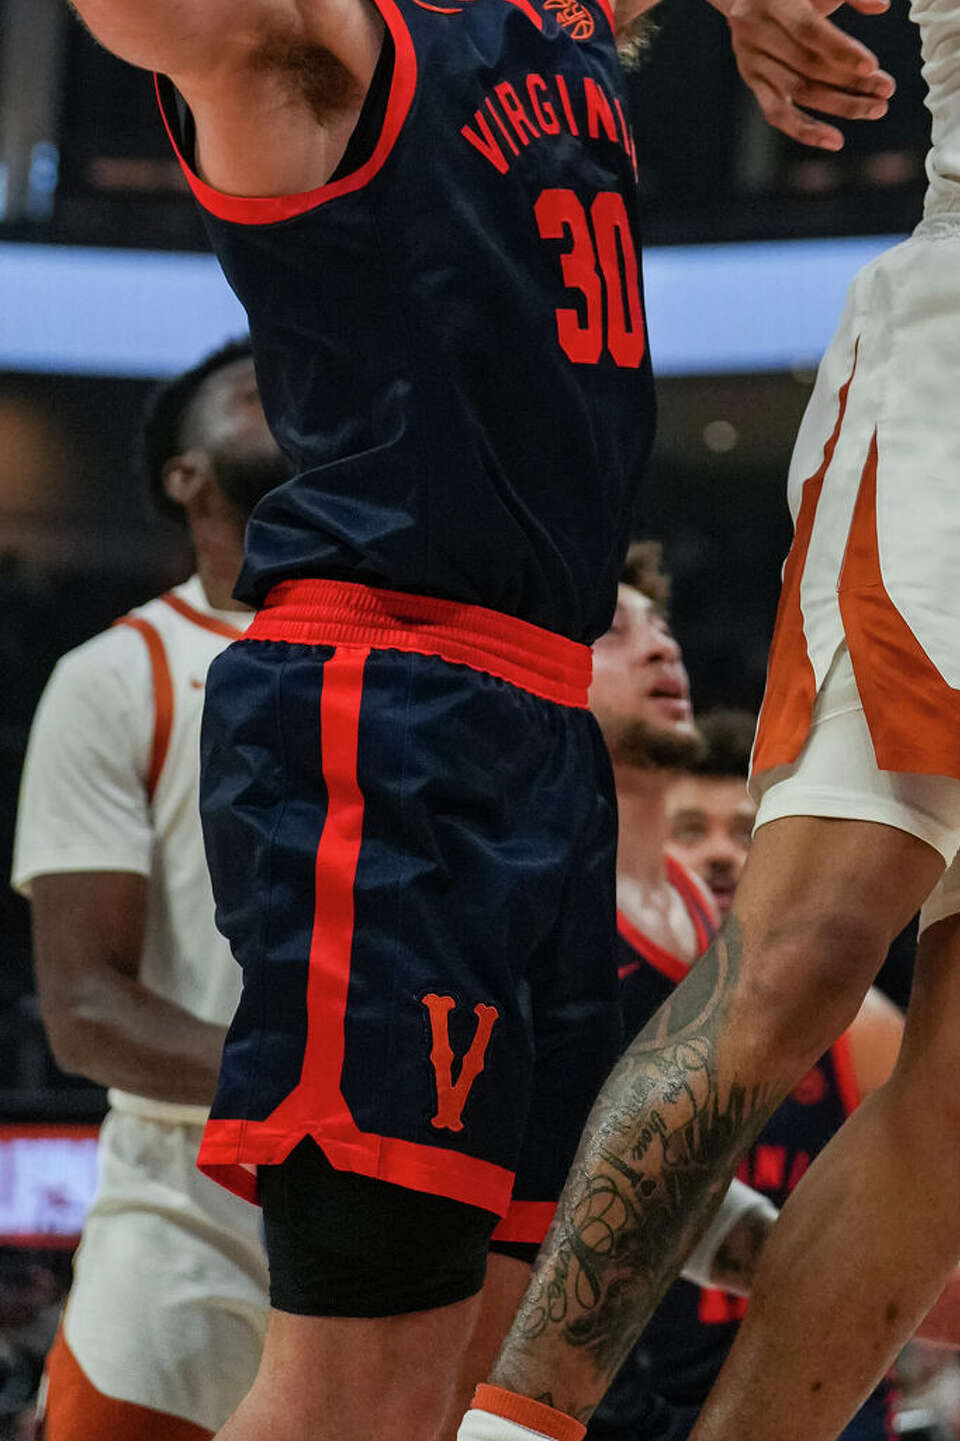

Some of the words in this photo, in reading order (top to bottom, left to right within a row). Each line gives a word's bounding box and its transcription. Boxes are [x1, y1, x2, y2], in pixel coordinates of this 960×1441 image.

[461, 73, 638, 185] VIRGINI
[534, 189, 645, 368] 30
[421, 993, 498, 1132] V
